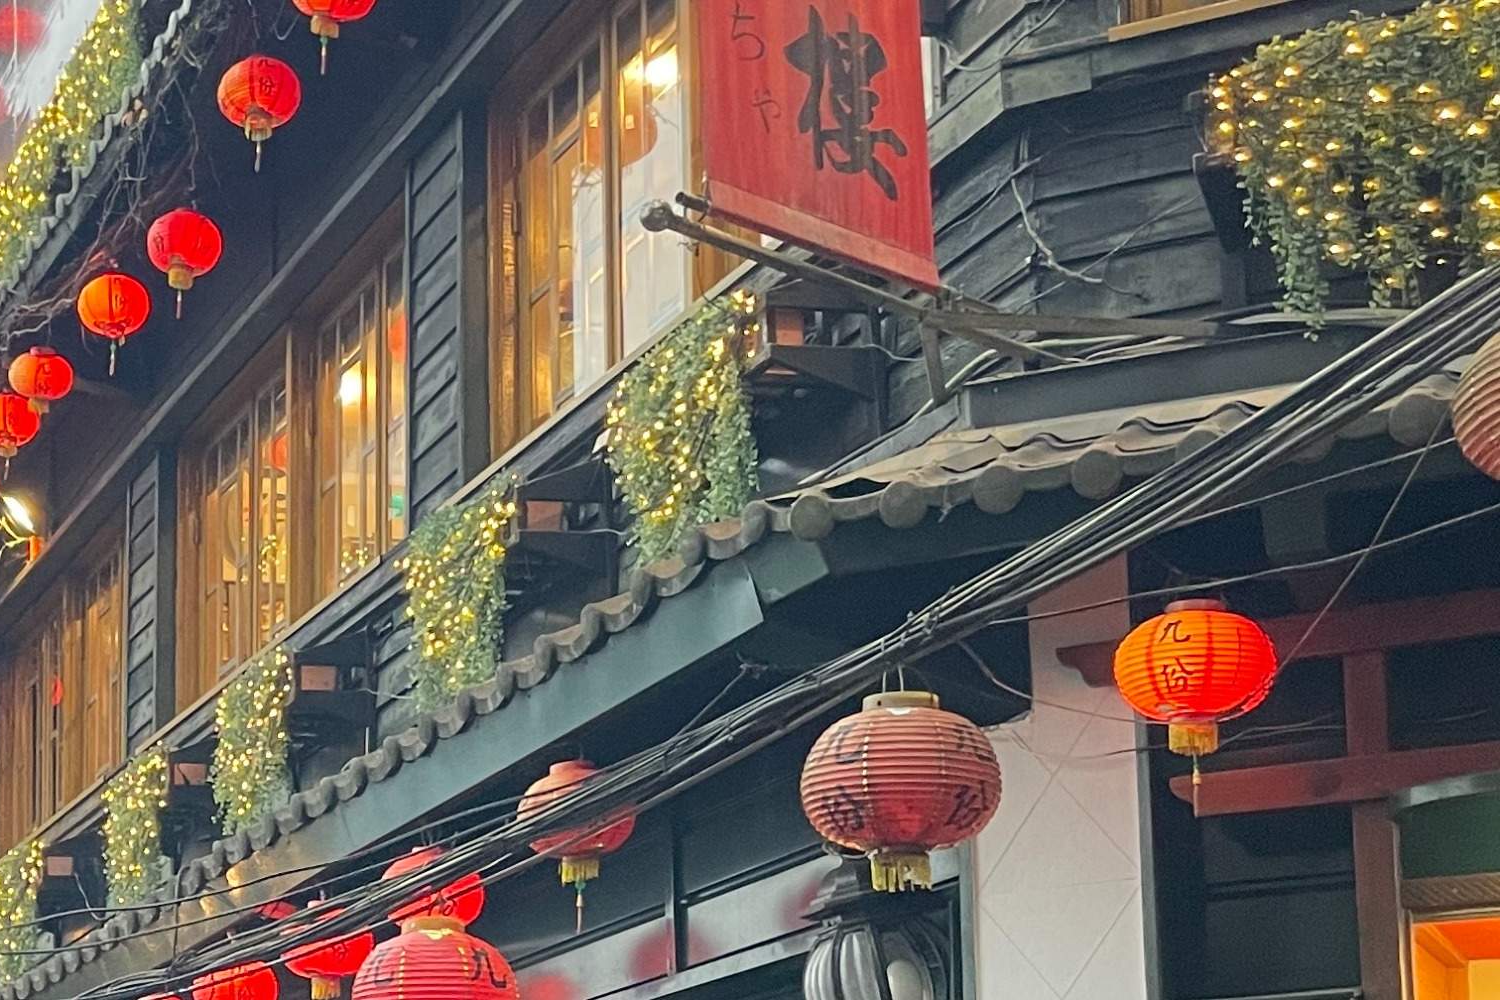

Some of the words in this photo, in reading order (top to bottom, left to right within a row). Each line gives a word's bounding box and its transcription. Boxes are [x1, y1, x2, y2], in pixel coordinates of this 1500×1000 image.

[782, 3, 908, 201] 樓
[1159, 619, 1194, 694] 九份
[470, 946, 508, 989] 九
